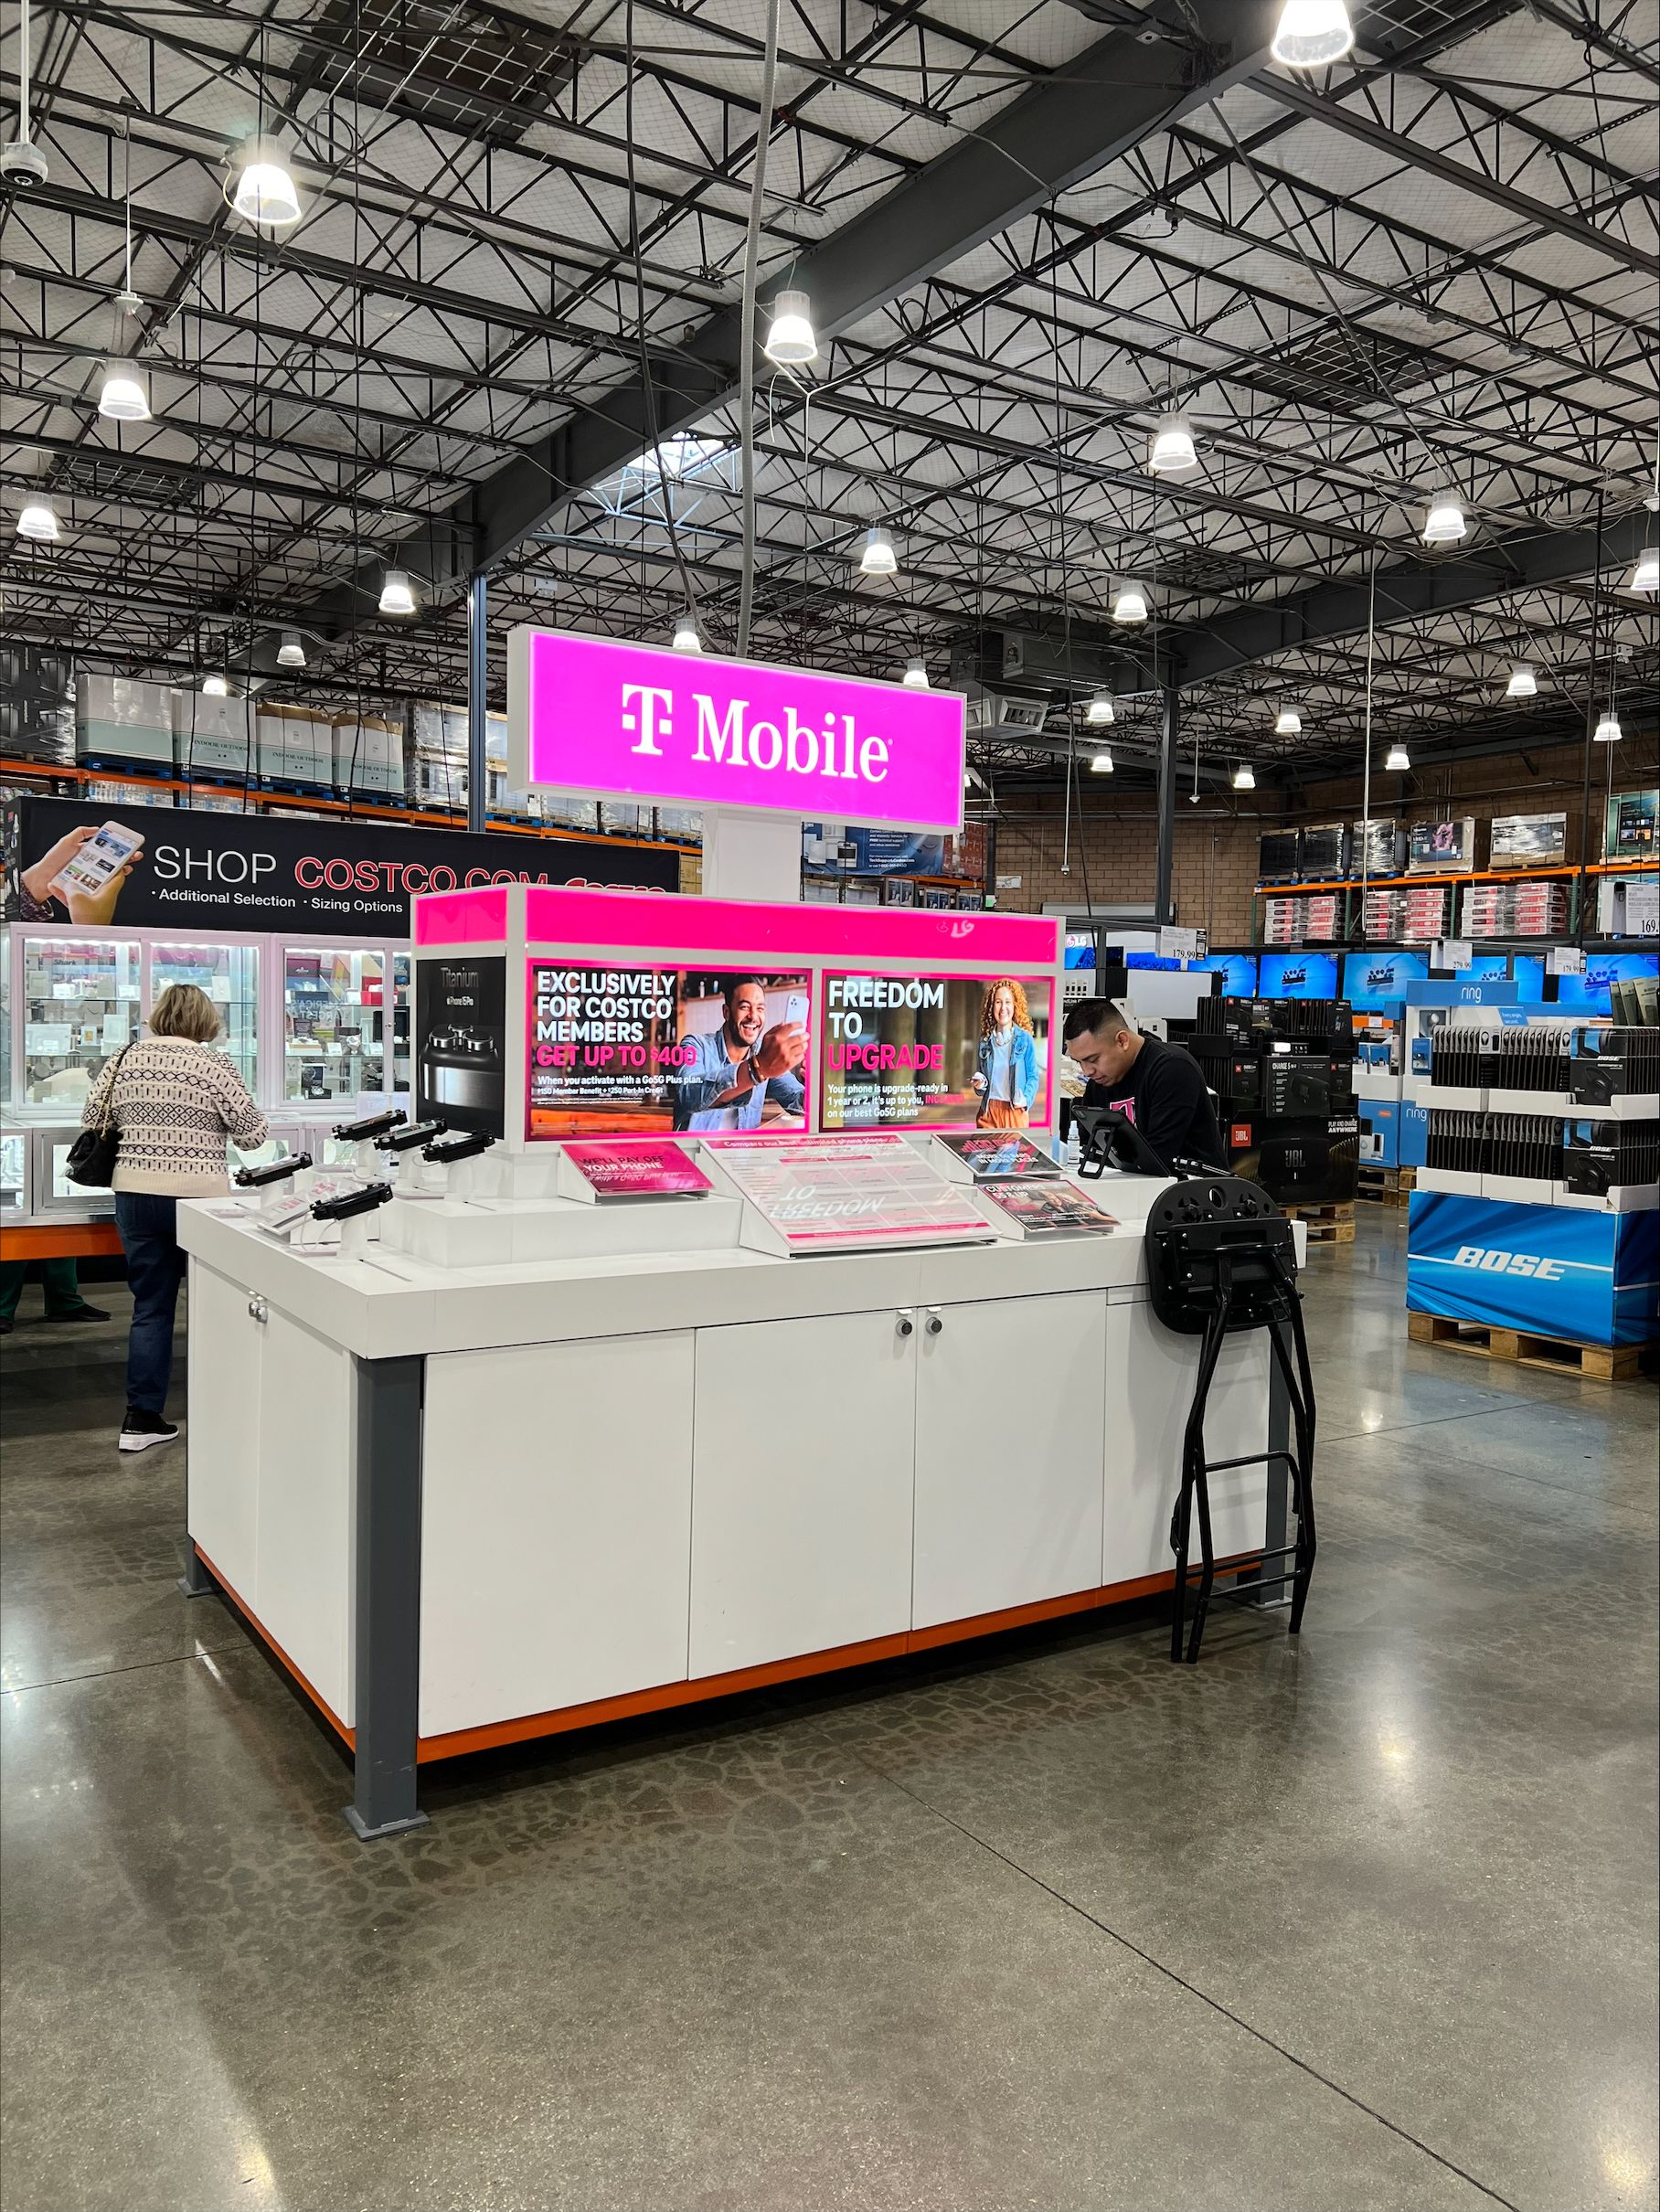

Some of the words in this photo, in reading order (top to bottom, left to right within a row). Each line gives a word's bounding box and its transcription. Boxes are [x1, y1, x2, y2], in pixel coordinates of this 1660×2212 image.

[691, 693, 889, 782] Mobile
[154, 845, 277, 884] SHOP
[159, 888, 229, 904] Additional
[233, 891, 296, 908] Selection
[311, 898, 350, 912] Sizing
[354, 899, 403, 913] Options
[1173, 949, 1196, 960] 179.99
[441, 967, 479, 987] Titanium
[537, 971, 675, 995] EXCLUSIVELY
[828, 980, 944, 1009] FREEDOM
[1461, 986, 1482, 1004] ring
[537, 996, 580, 1018] FOR
[586, 997, 673, 1020] COSTCO
[537, 1020, 644, 1042] MEMBERS
[828, 1013, 863, 1038] TO
[537, 1046, 579, 1066] GET
[583, 1046, 614, 1066] UP
[618, 1046, 646, 1066] TO
[650, 1046, 697, 1068] $400
[828, 1044, 945, 1071] UPGRADE
[537, 1075, 563, 1085] When
[564, 1078, 580, 1087] you
[581, 1076, 614, 1085] activate
[616, 1075, 633, 1084] with
[642, 1076, 665, 1085] Go5G
[665, 1075, 683, 1084] Plus
[683, 1076, 704, 1086] plan.
[580, 1087, 601, 1095] Benefit
[828, 1084, 846, 1093] Your
[848, 1084, 873, 1095] phone
[874, 1084, 881, 1093] is
[882, 1083, 940, 1095] upgrade-ready
[941, 1083, 949, 1092] in
[828, 1097, 832, 1105] 1
[834, 1098, 851, 1107] year
[872, 1096, 885, 1105] it's
[886, 1098, 896, 1106] up
[897, 1096, 906, 1105] to
[907, 1097, 924, 1106] you,
[827, 1110, 837, 1118] on
[855, 1108, 872, 1117] best
[874, 1107, 896, 1117] Go5G
[897, 1107, 918, 1118] plans
[1406, 1108, 1427, 1122] ring
[1236, 1131, 1248, 1141] JBL
[583, 1164, 620, 1173] YOUR
[622, 1162, 664, 1171] PHONE
[1285, 1150, 1305, 1167] JBL
[1453, 1246, 1565, 1281] BOSE
